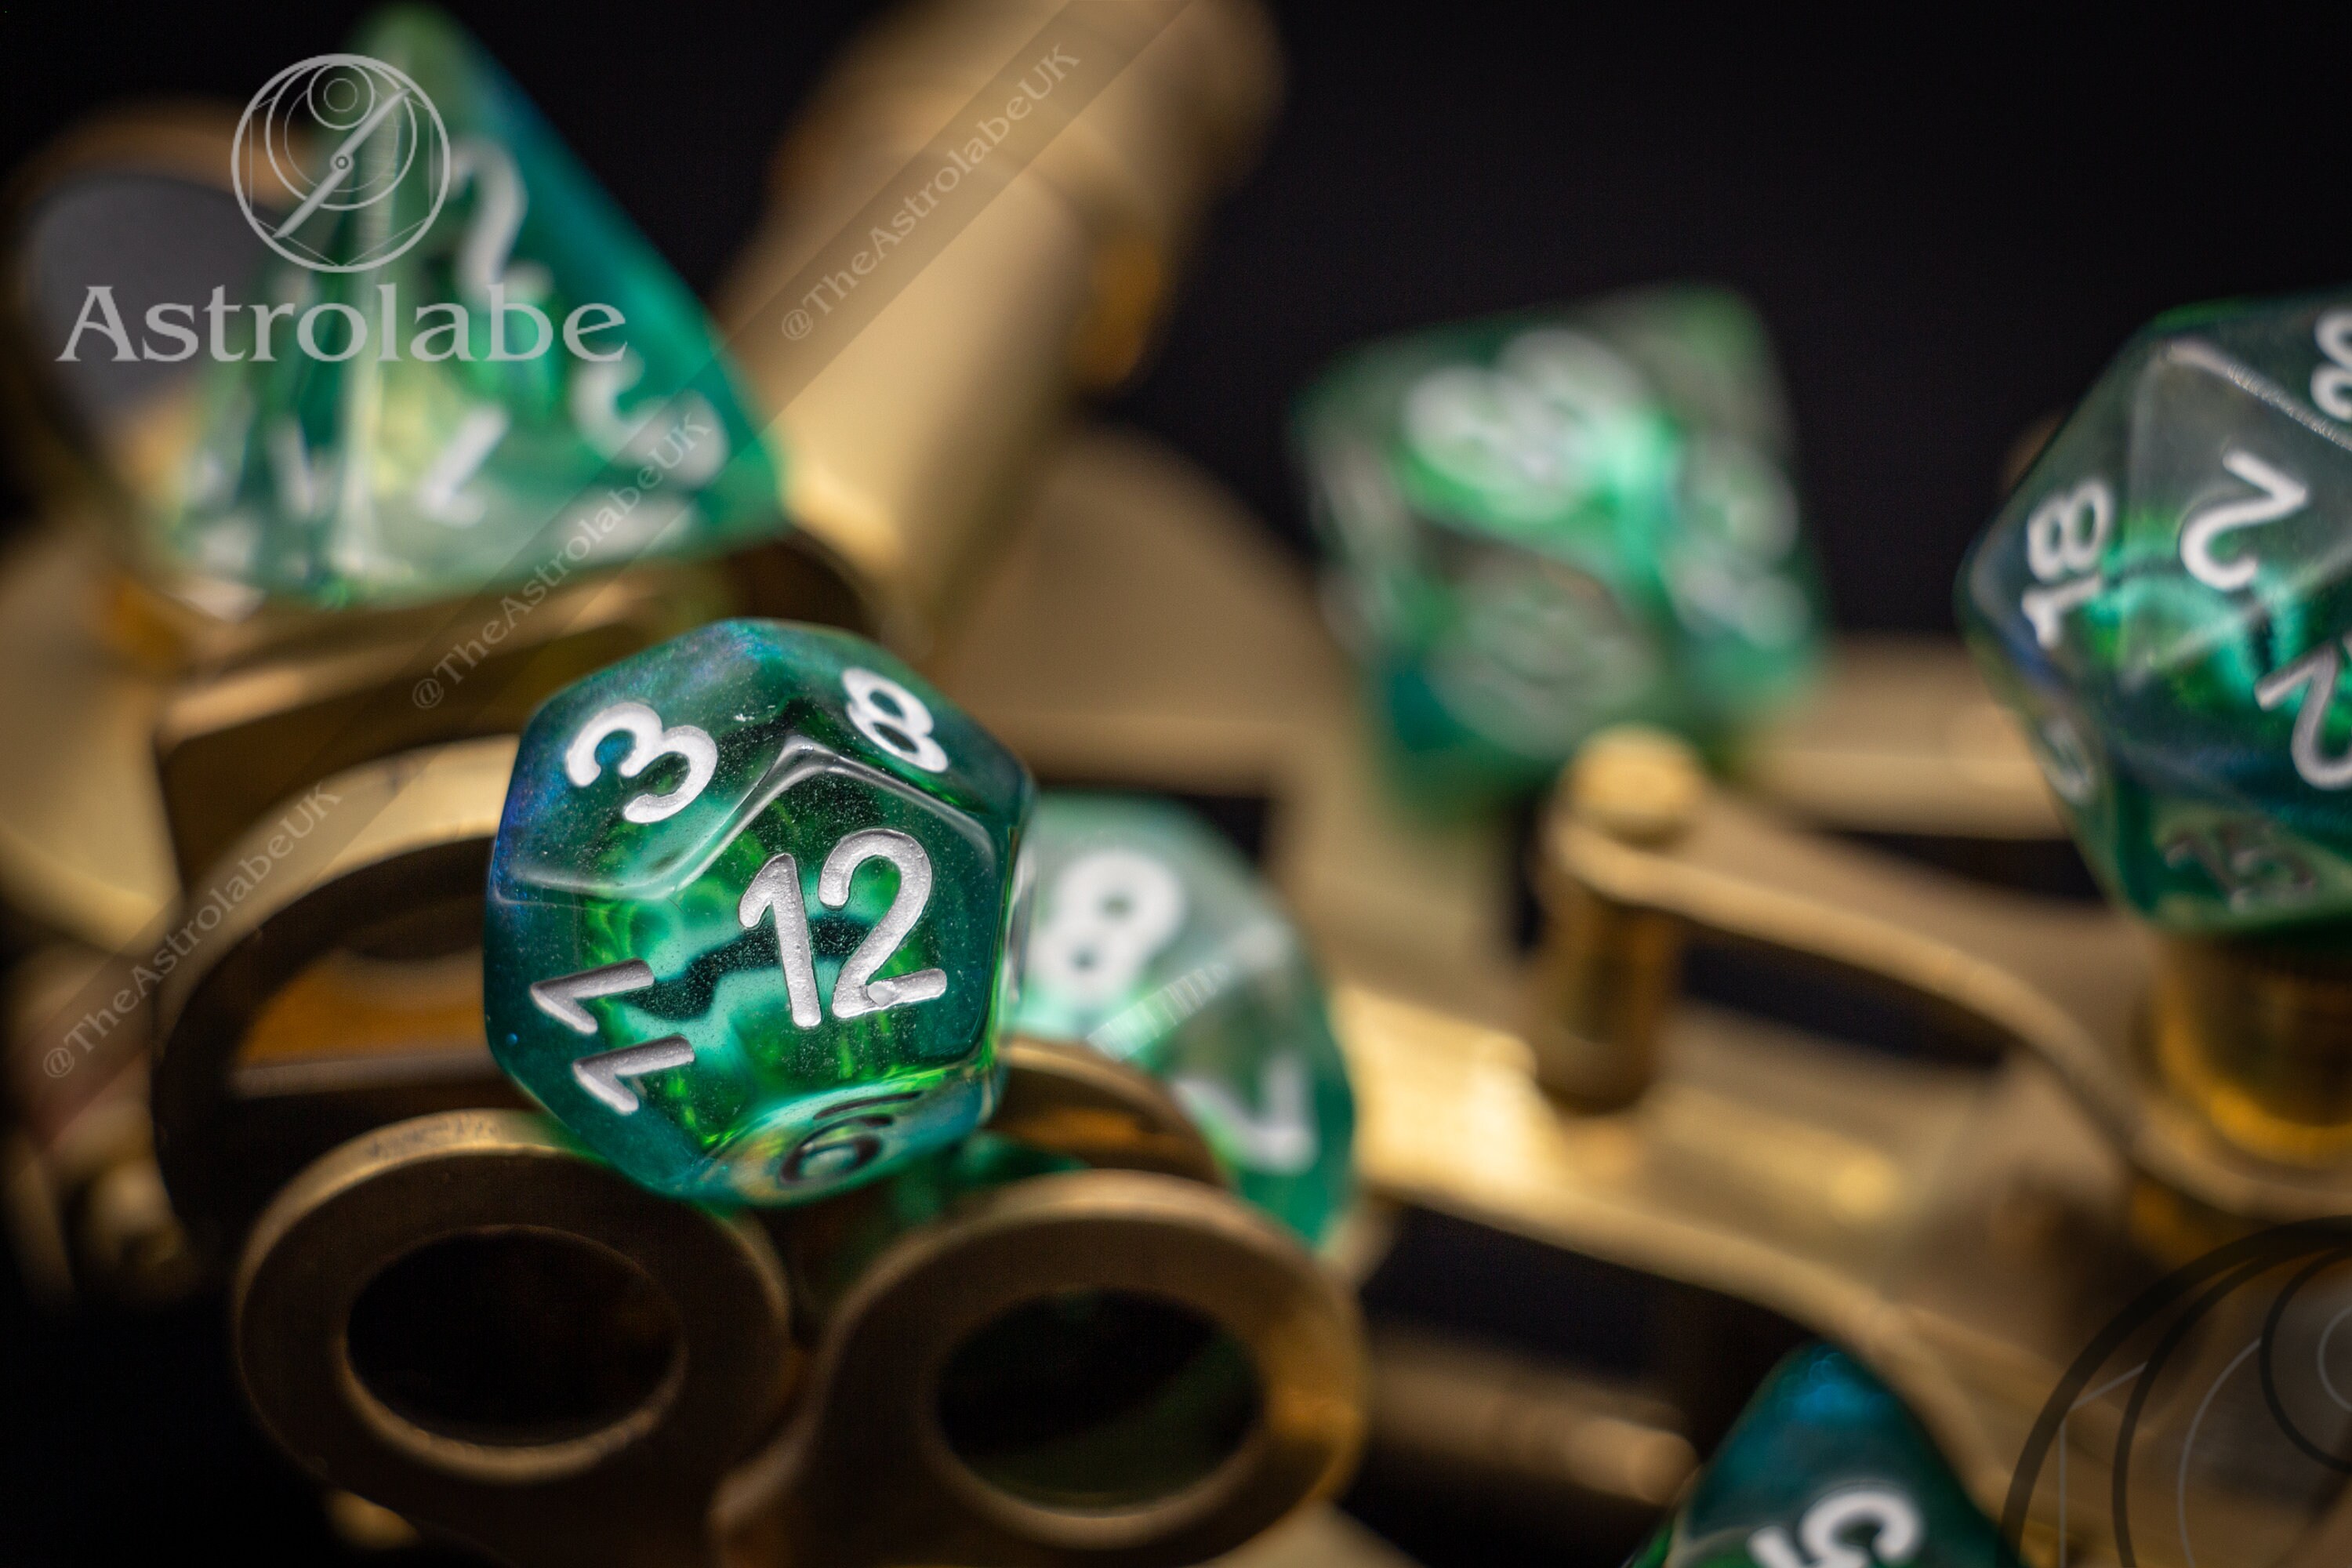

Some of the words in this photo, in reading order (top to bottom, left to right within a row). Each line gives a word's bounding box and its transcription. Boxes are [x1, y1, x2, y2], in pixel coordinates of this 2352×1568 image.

[2022, 478, 2114, 650] 18
[565, 702, 718, 824] 3
[841, 666, 949, 772] 8
[738, 827, 948, 1029] 12
[530, 957, 696, 1116] 11
